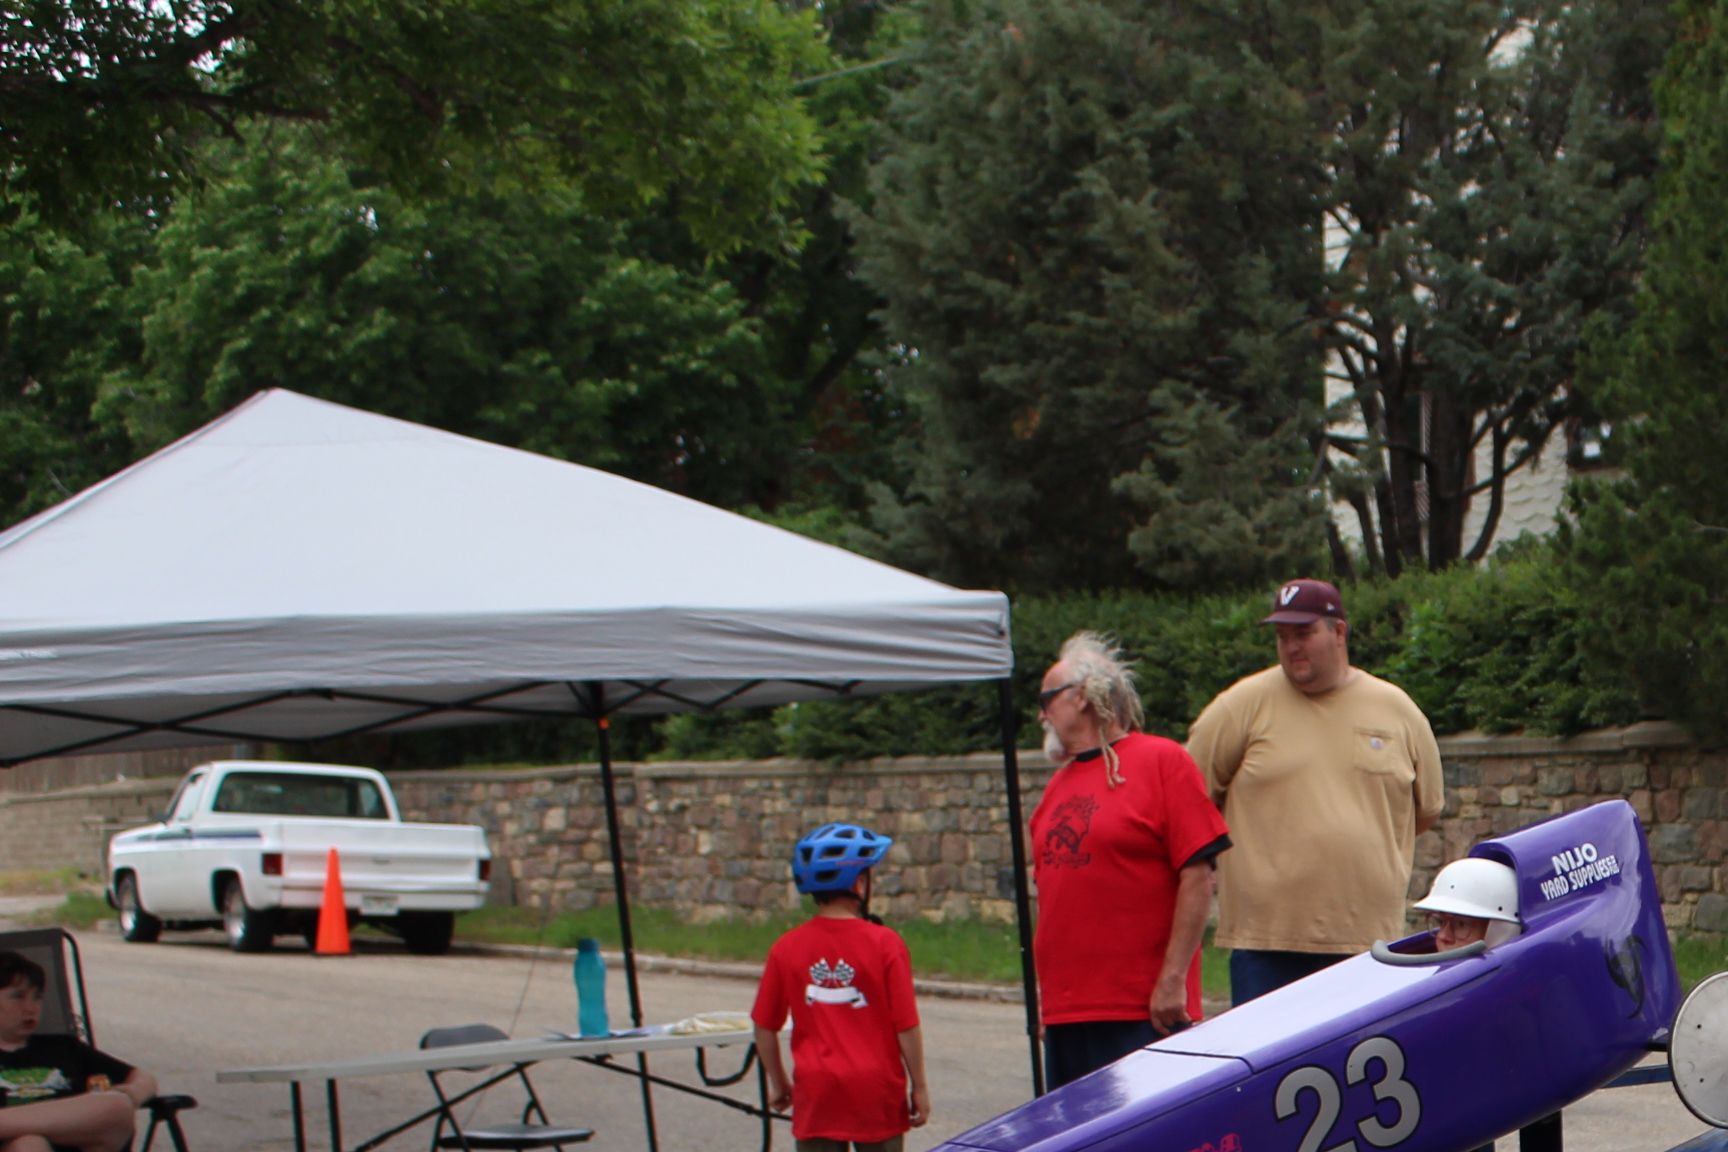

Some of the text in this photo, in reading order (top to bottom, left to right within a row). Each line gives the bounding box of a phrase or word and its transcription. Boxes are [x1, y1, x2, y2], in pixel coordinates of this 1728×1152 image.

[1551, 842, 1598, 875] NIJO
[1540, 875, 1570, 901] YARD
[1568, 857, 1611, 891] SUPPLIES
